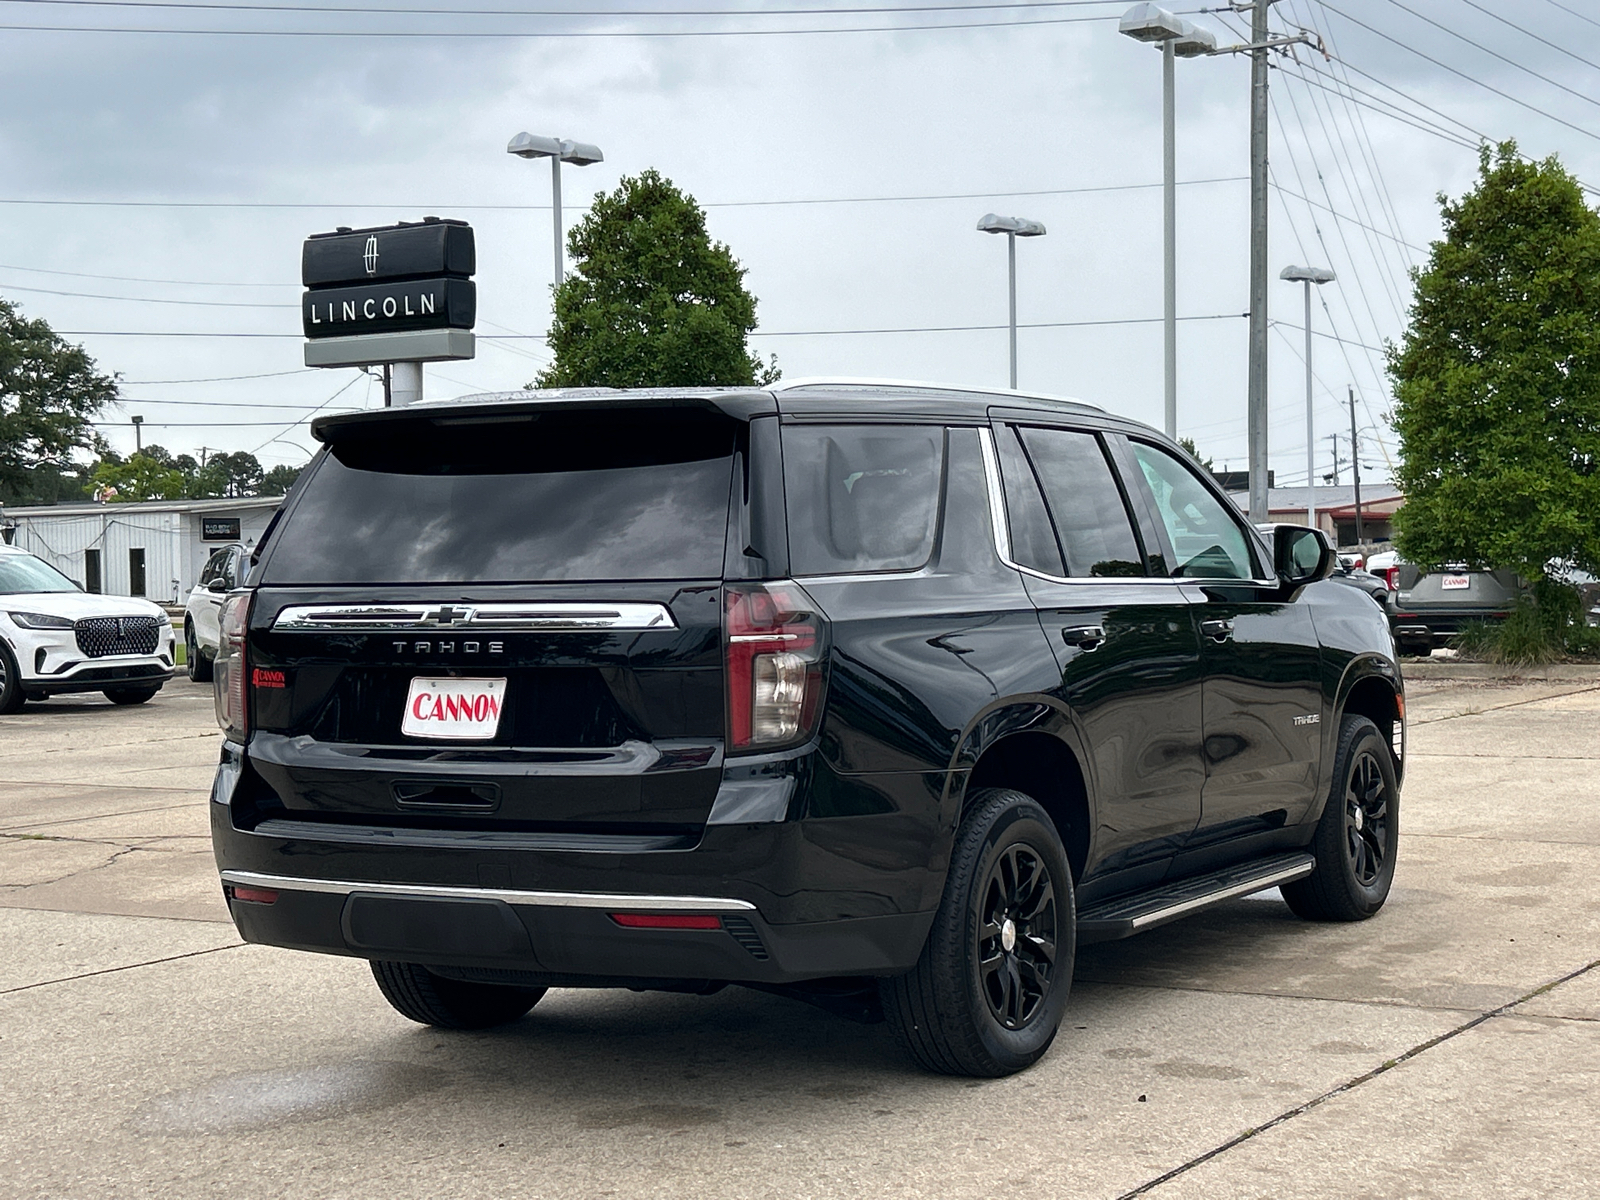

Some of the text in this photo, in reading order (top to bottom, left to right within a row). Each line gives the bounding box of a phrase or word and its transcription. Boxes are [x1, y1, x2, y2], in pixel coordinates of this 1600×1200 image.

[311, 293, 435, 324] LINCOLN
[392, 641, 504, 653] TAHOE
[260, 671, 285, 682] CANNON
[412, 692, 502, 723] CANNON
[1293, 714, 1320, 726] TAHOE
